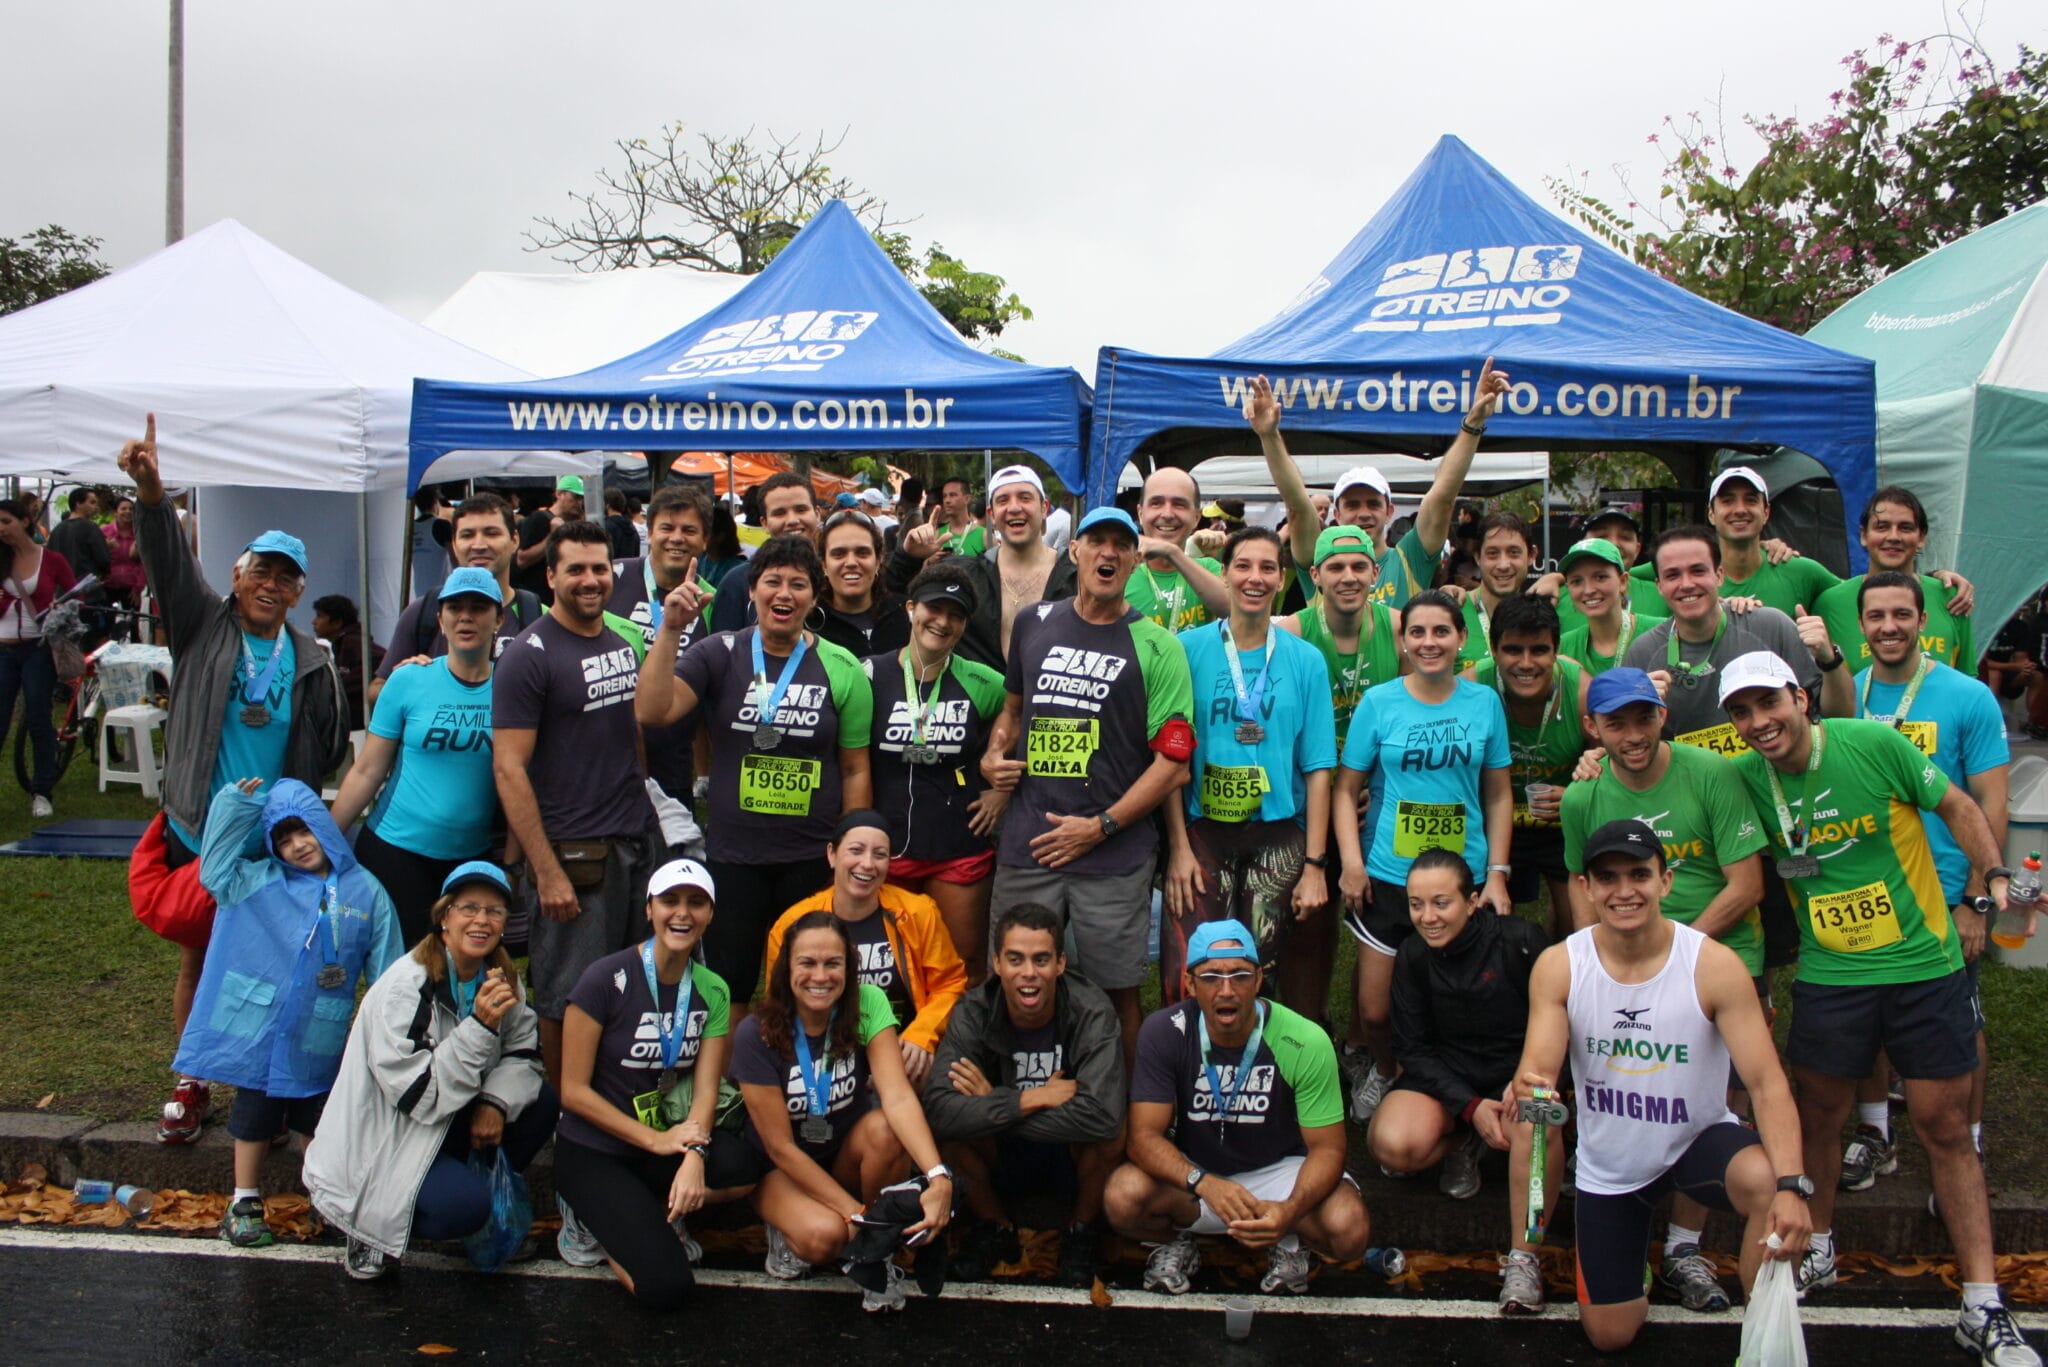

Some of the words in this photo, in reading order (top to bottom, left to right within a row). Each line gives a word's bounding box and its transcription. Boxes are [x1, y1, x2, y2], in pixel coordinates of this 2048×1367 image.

[1370, 285, 1571, 318] OTREINO
[666, 343, 845, 374] OTREINO
[508, 388, 954, 432] www.otreino.com.br
[587, 672, 638, 700] OTREINO
[1037, 673, 1110, 700] OTREINO
[432, 711, 493, 728] FAMIL
[422, 727, 493, 752] RUN
[1030, 733, 1089, 753] 21824
[1406, 723, 1472, 749] FAMILY
[1033, 760, 1082, 774] CAIXA
[1401, 742, 1472, 773] RUN
[746, 769, 811, 793] 19650
[1204, 777, 1262, 799] 19655
[755, 799, 806, 811] GATORADE
[1401, 815, 1465, 836] 19283
[1425, 836, 1440, 844] Ana
[1814, 894, 1892, 929] 13185
[1840, 922, 1873, 934] Wagner
[1586, 1037, 1689, 1064] BRMOVE
[1585, 1085, 1690, 1125] ENIGMA
